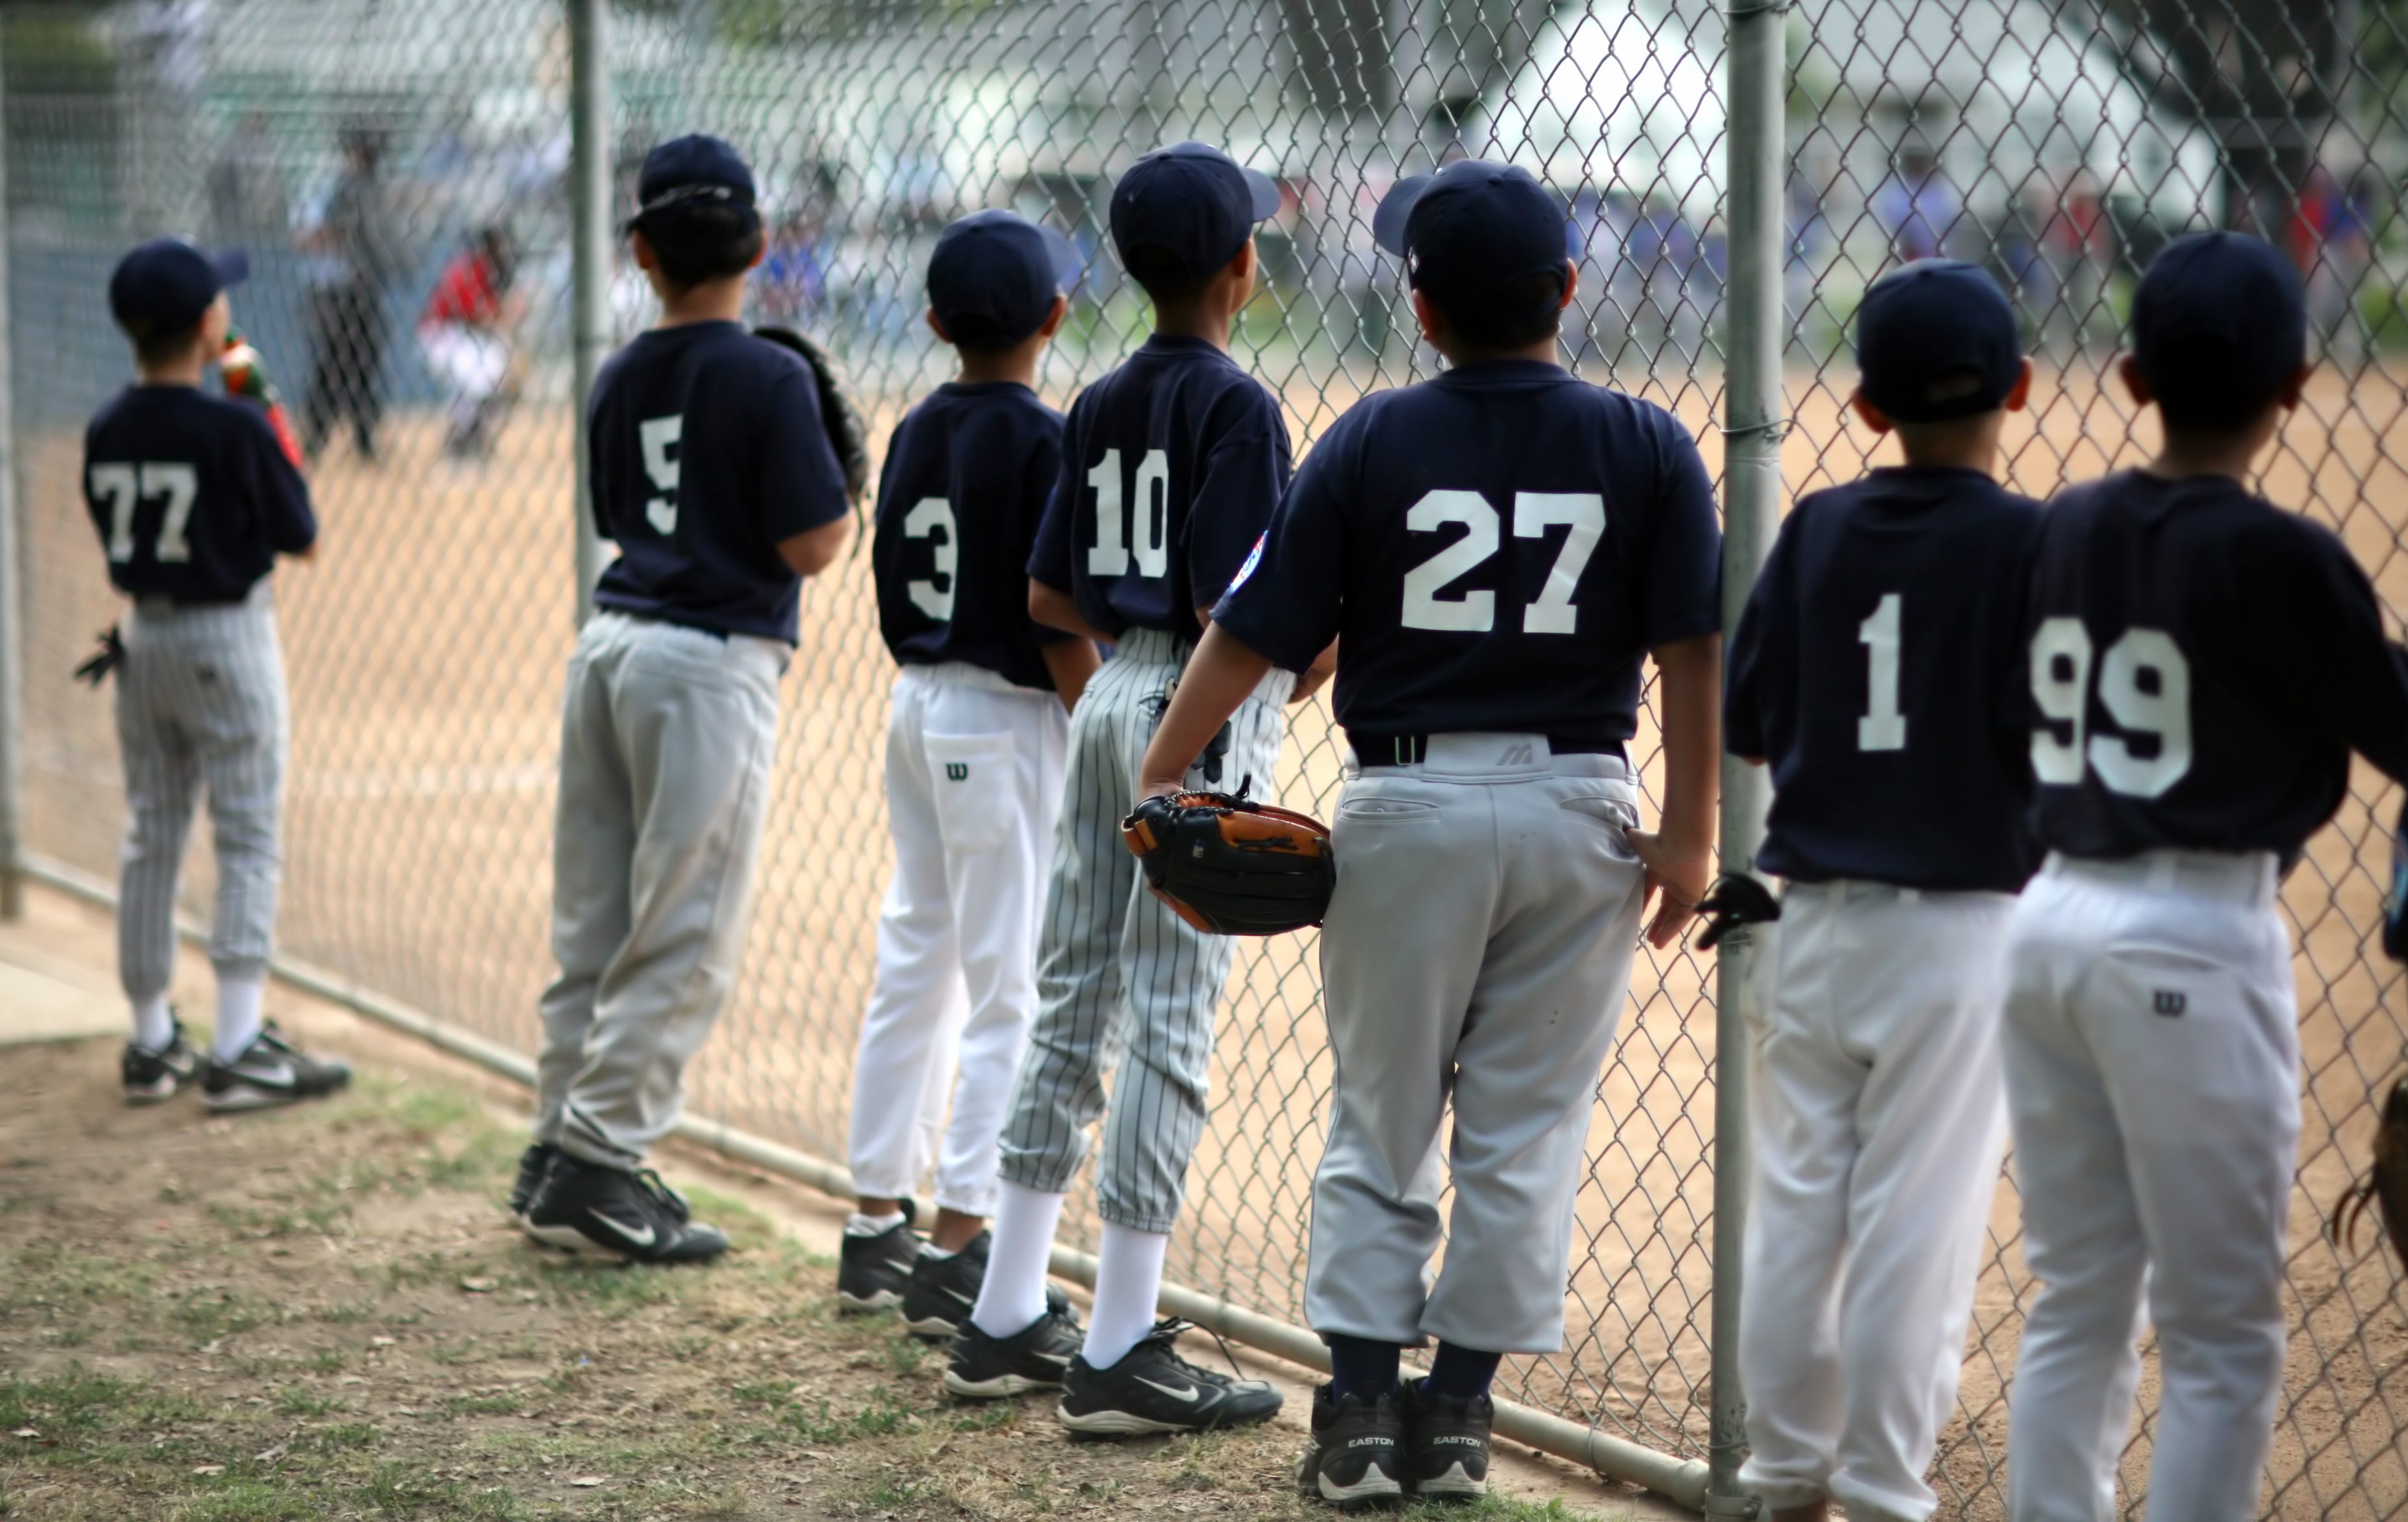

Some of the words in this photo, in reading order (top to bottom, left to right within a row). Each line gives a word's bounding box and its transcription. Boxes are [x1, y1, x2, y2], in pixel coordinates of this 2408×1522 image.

[90, 463, 196, 560] 77
[641, 415, 682, 535] 5
[1088, 449, 1169, 578] 10
[905, 498, 958, 621] 3
[1402, 490, 1606, 634] 27
[1859, 594, 1906, 751] 1
[2031, 619, 2190, 798] 99
[1348, 1437, 1394, 1448] EASTON
[1434, 1437, 1481, 1448] EASTON
